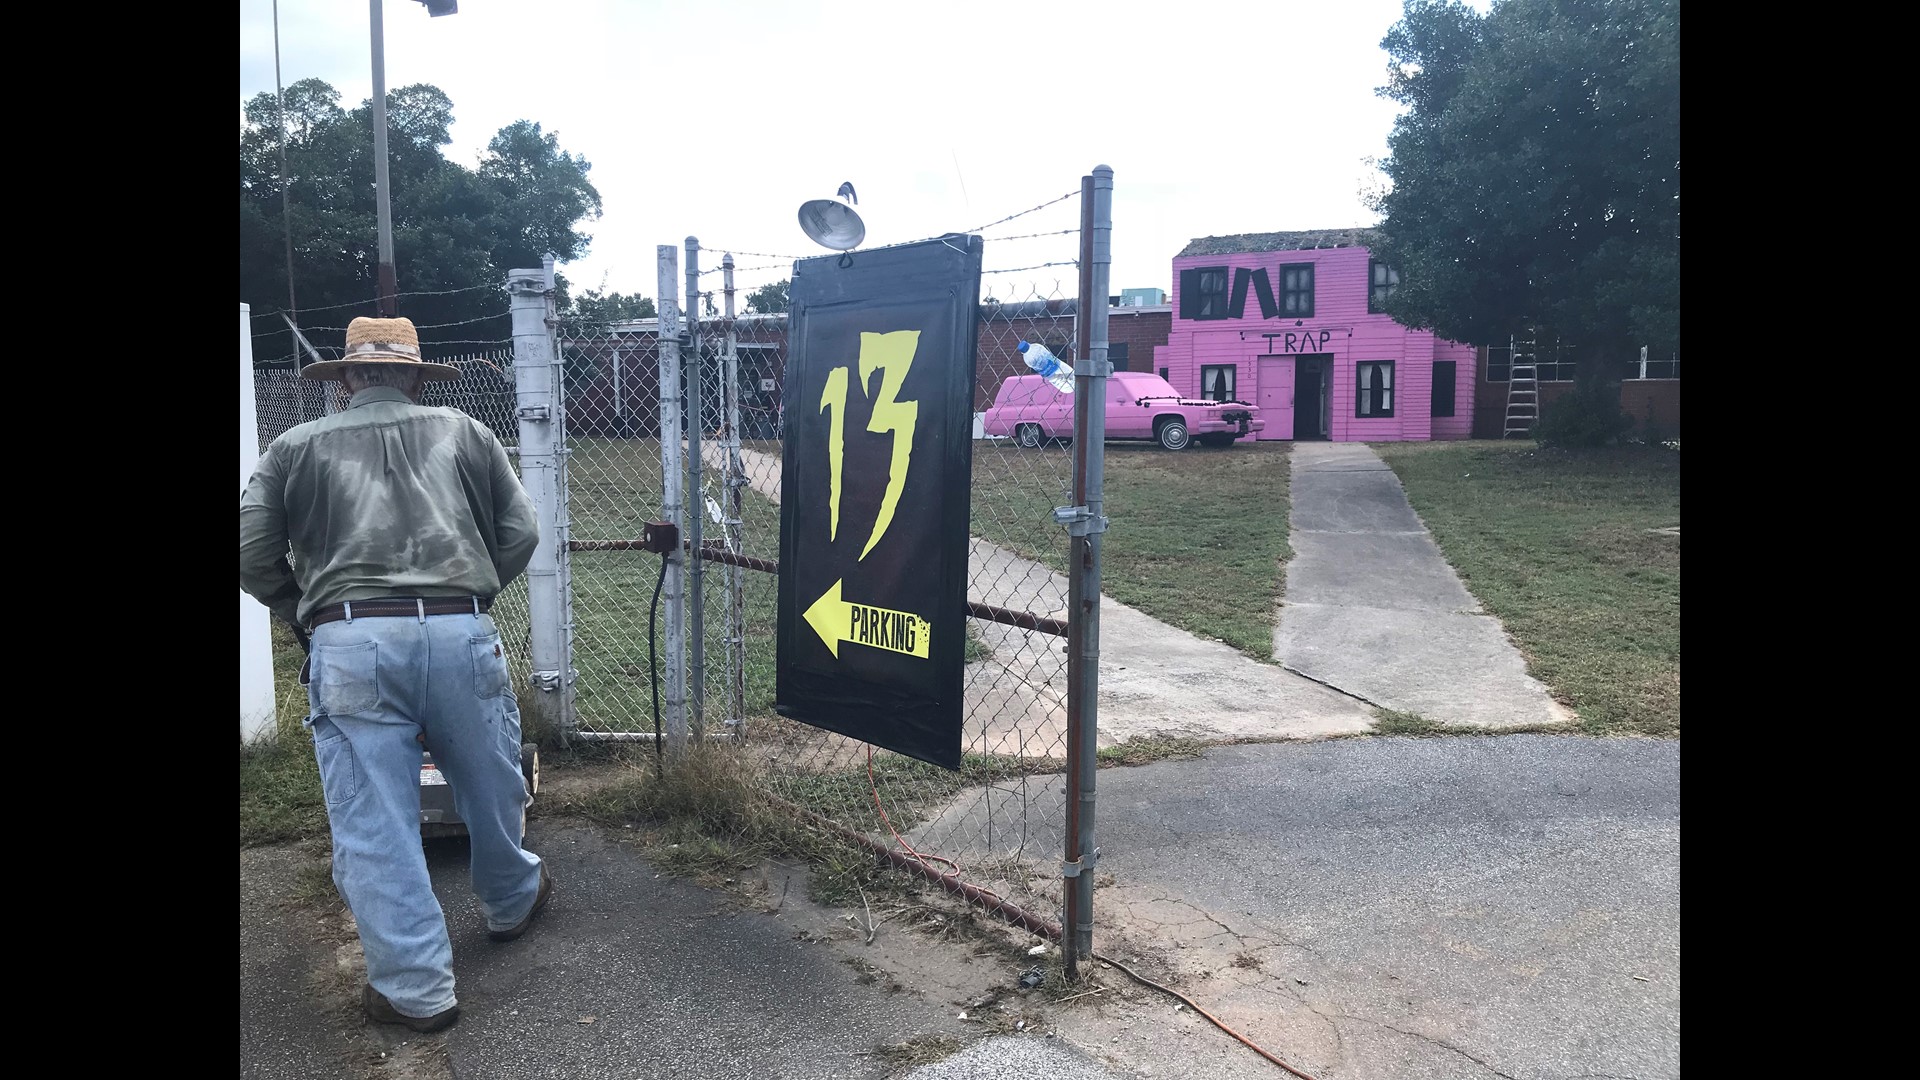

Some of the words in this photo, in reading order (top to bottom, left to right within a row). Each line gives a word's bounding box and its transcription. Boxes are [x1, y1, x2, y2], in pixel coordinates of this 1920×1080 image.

[1262, 331, 1331, 354] TRAP
[819, 329, 921, 562] 13
[850, 605, 916, 653] PARKING
